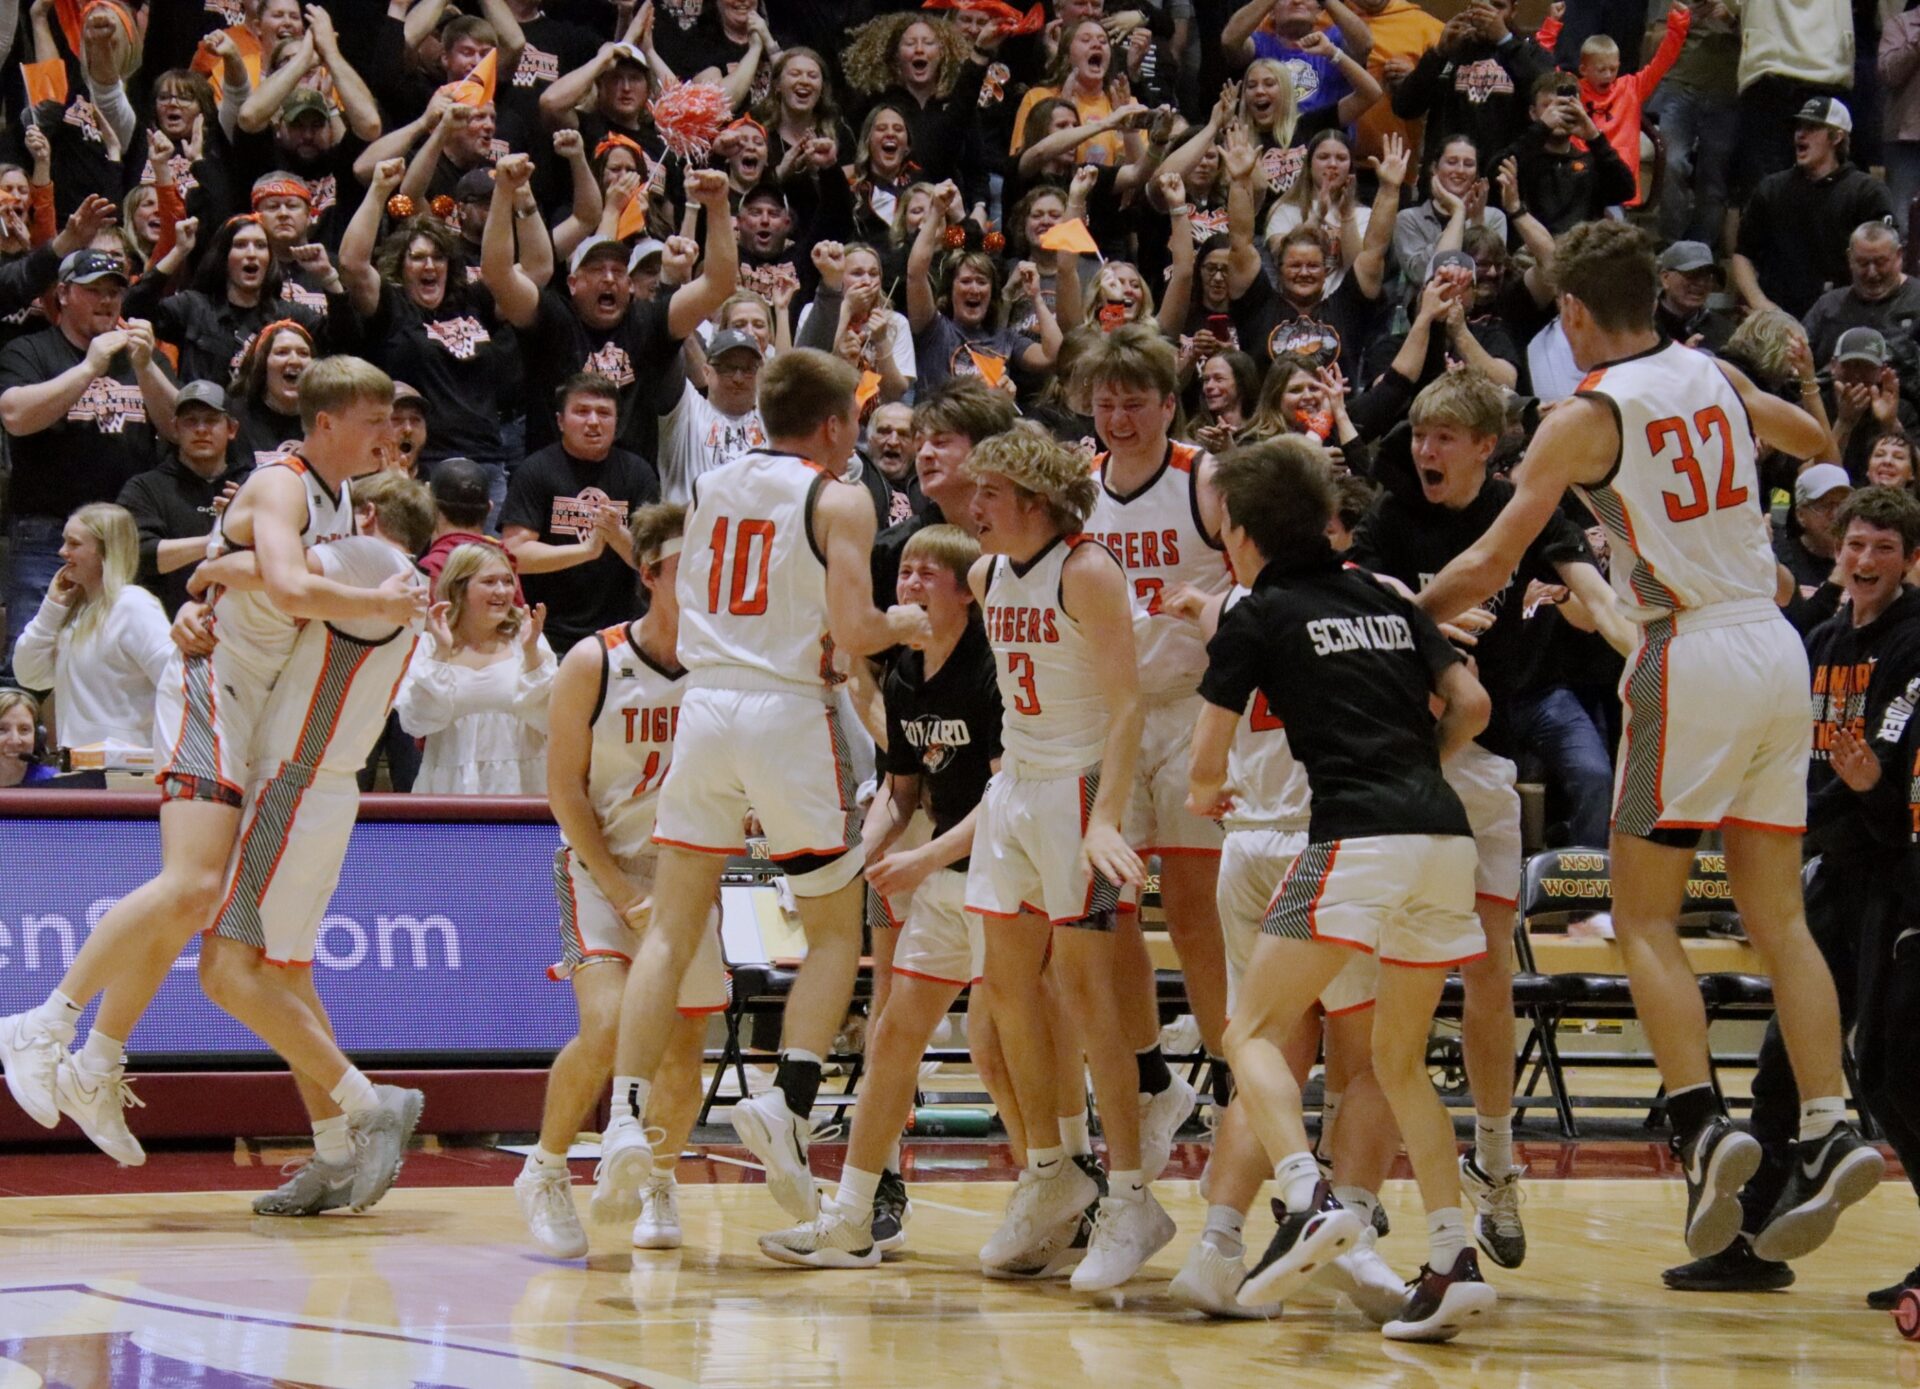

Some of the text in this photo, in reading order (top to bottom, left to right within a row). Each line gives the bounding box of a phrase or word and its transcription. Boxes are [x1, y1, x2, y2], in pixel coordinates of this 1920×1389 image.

[1645, 404, 1749, 523] 32
[707, 516, 776, 616] 10
[1084, 529, 1180, 568] GERS
[987, 606, 1060, 643] TIGERS
[1008, 651, 1042, 715] 3
[1558, 853, 1604, 871] NSU
[1700, 855, 1727, 872] NS
[1687, 880, 1734, 899] WOL
